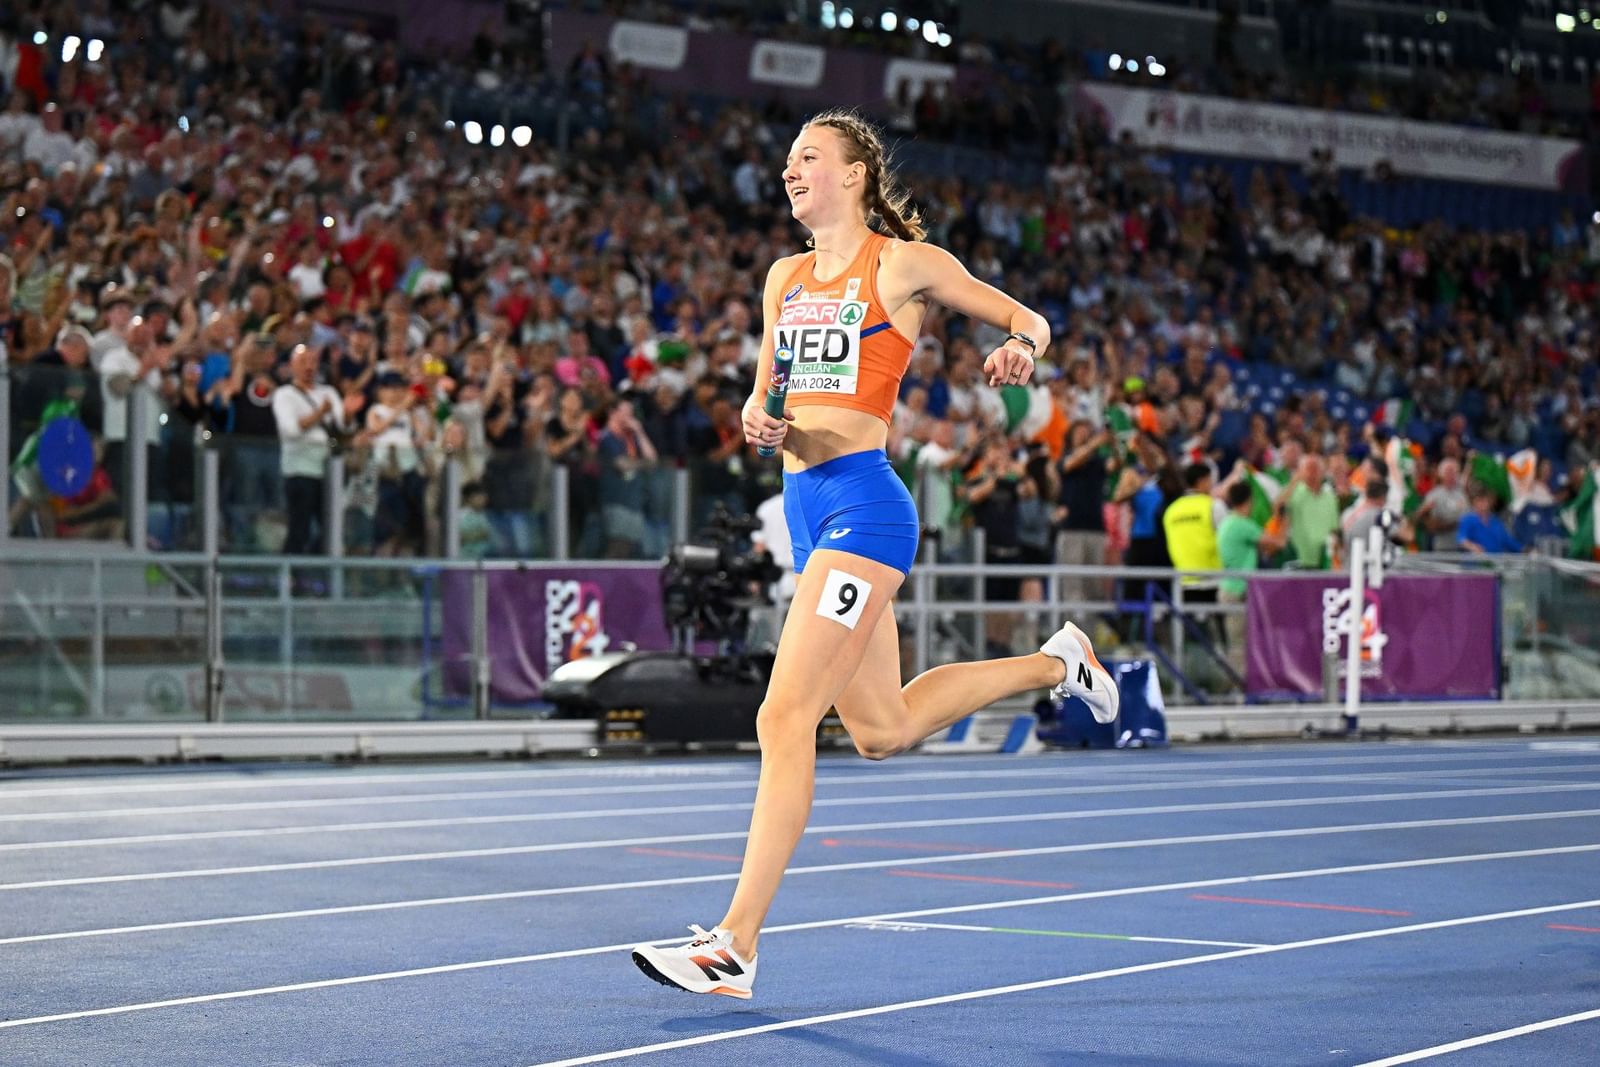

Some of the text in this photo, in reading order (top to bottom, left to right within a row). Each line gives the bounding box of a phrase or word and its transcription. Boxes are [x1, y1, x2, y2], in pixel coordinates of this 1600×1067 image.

[780, 305, 837, 324] SPAR
[779, 329, 850, 363] NED
[804, 364, 831, 373] CLEAN
[787, 377, 841, 390] OMA 2024
[835, 583, 858, 616] 9
